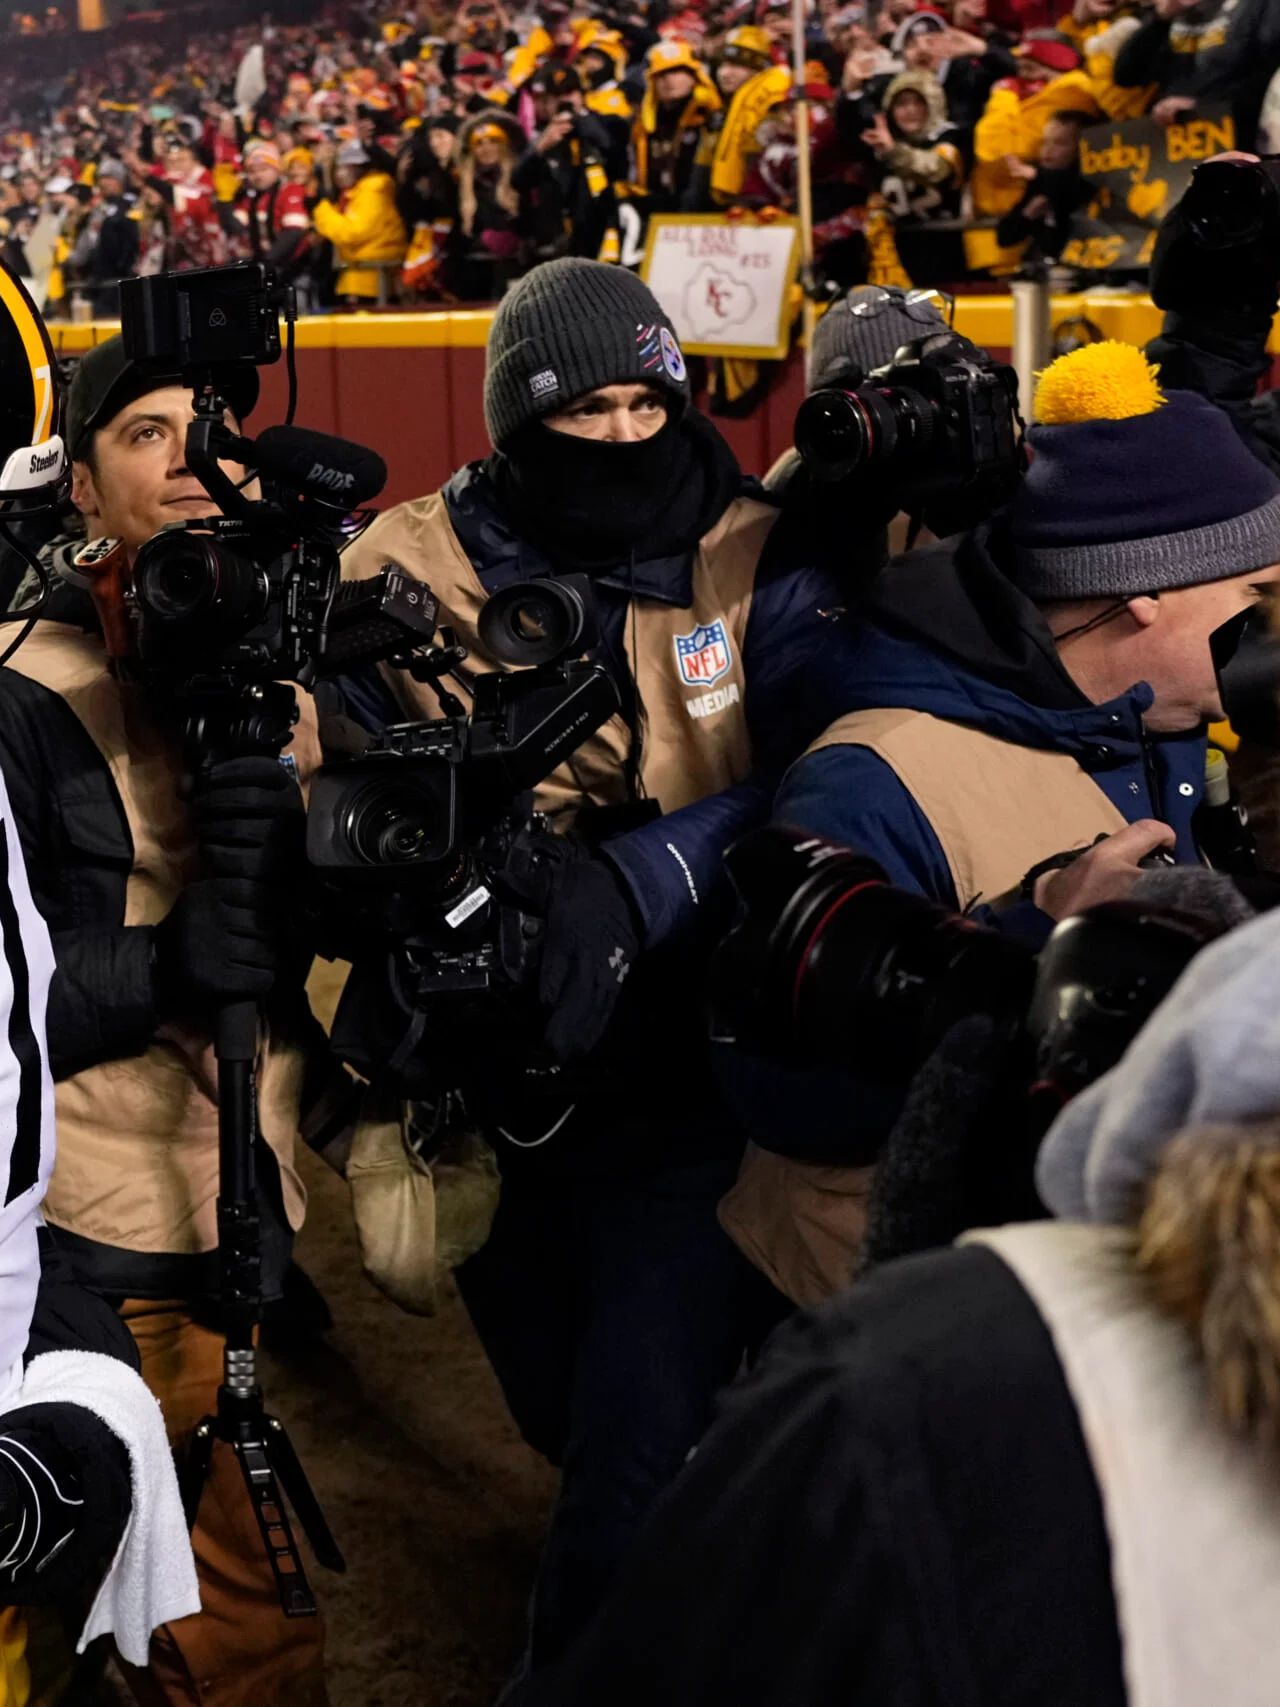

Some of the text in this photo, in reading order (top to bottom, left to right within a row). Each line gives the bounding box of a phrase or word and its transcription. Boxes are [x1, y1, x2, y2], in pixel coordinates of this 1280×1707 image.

[1079, 116, 1235, 184] baby BEN
[31, 364, 51, 446] 7
[684, 646, 726, 679] NFL
[686, 683, 740, 720] MEDIA
[666, 843, 699, 905] OMNI-HEAT
